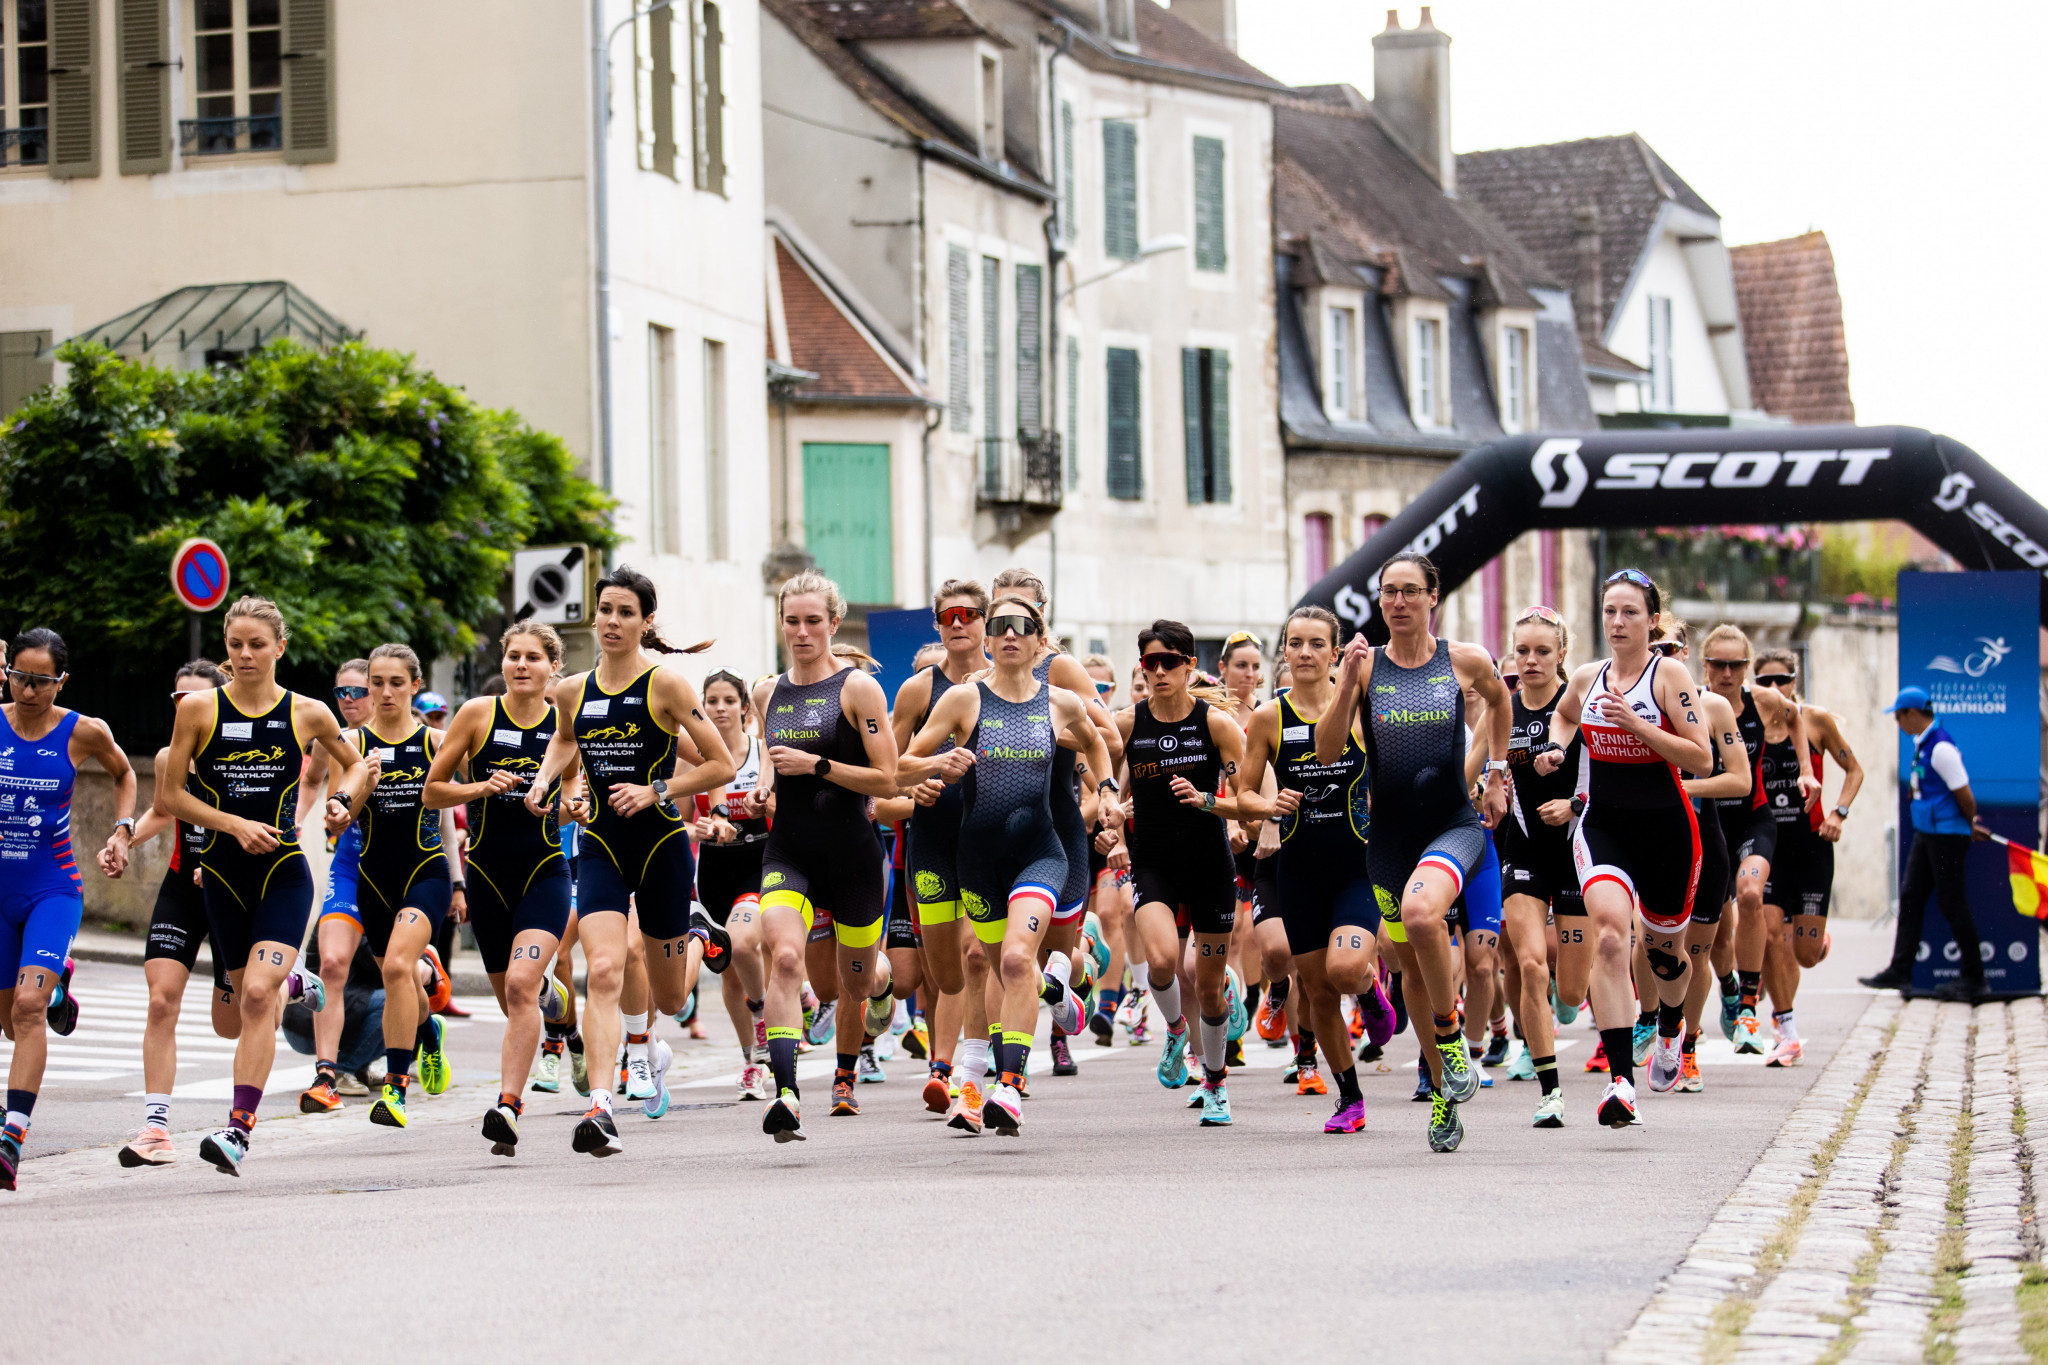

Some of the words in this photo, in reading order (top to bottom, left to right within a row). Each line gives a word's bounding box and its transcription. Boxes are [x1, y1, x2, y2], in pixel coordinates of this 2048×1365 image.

[1595, 448, 1892, 490] SCOTT
[1931, 701, 2007, 714] TRIATHLON
[1390, 709, 1450, 723] Meaux
[780, 728, 821, 739] Meaux
[866, 718, 879, 735] 5
[1591, 730, 1643, 746] RENNES
[993, 746, 1046, 759] Meaux
[1591, 744, 1650, 757] TRIATHLON
[1160, 754, 1208, 767] STRASBOURG
[1303, 760, 1354, 770] PALASEAU
[1297, 769, 1347, 778] TRIATHLON
[4, 830, 30, 838] Région
[730, 912, 753, 923] 25
[1027, 915, 1040, 932] 3
[1335, 934, 1362, 950] 16
[1478, 934, 1497, 948] 14
[1561, 929, 1583, 944] 35
[513, 945, 541, 960] 20
[663, 939, 685, 959] 18
[1201, 943, 1226, 957] 34
[257, 948, 284, 966] 19
[851, 960, 863, 973] 5
